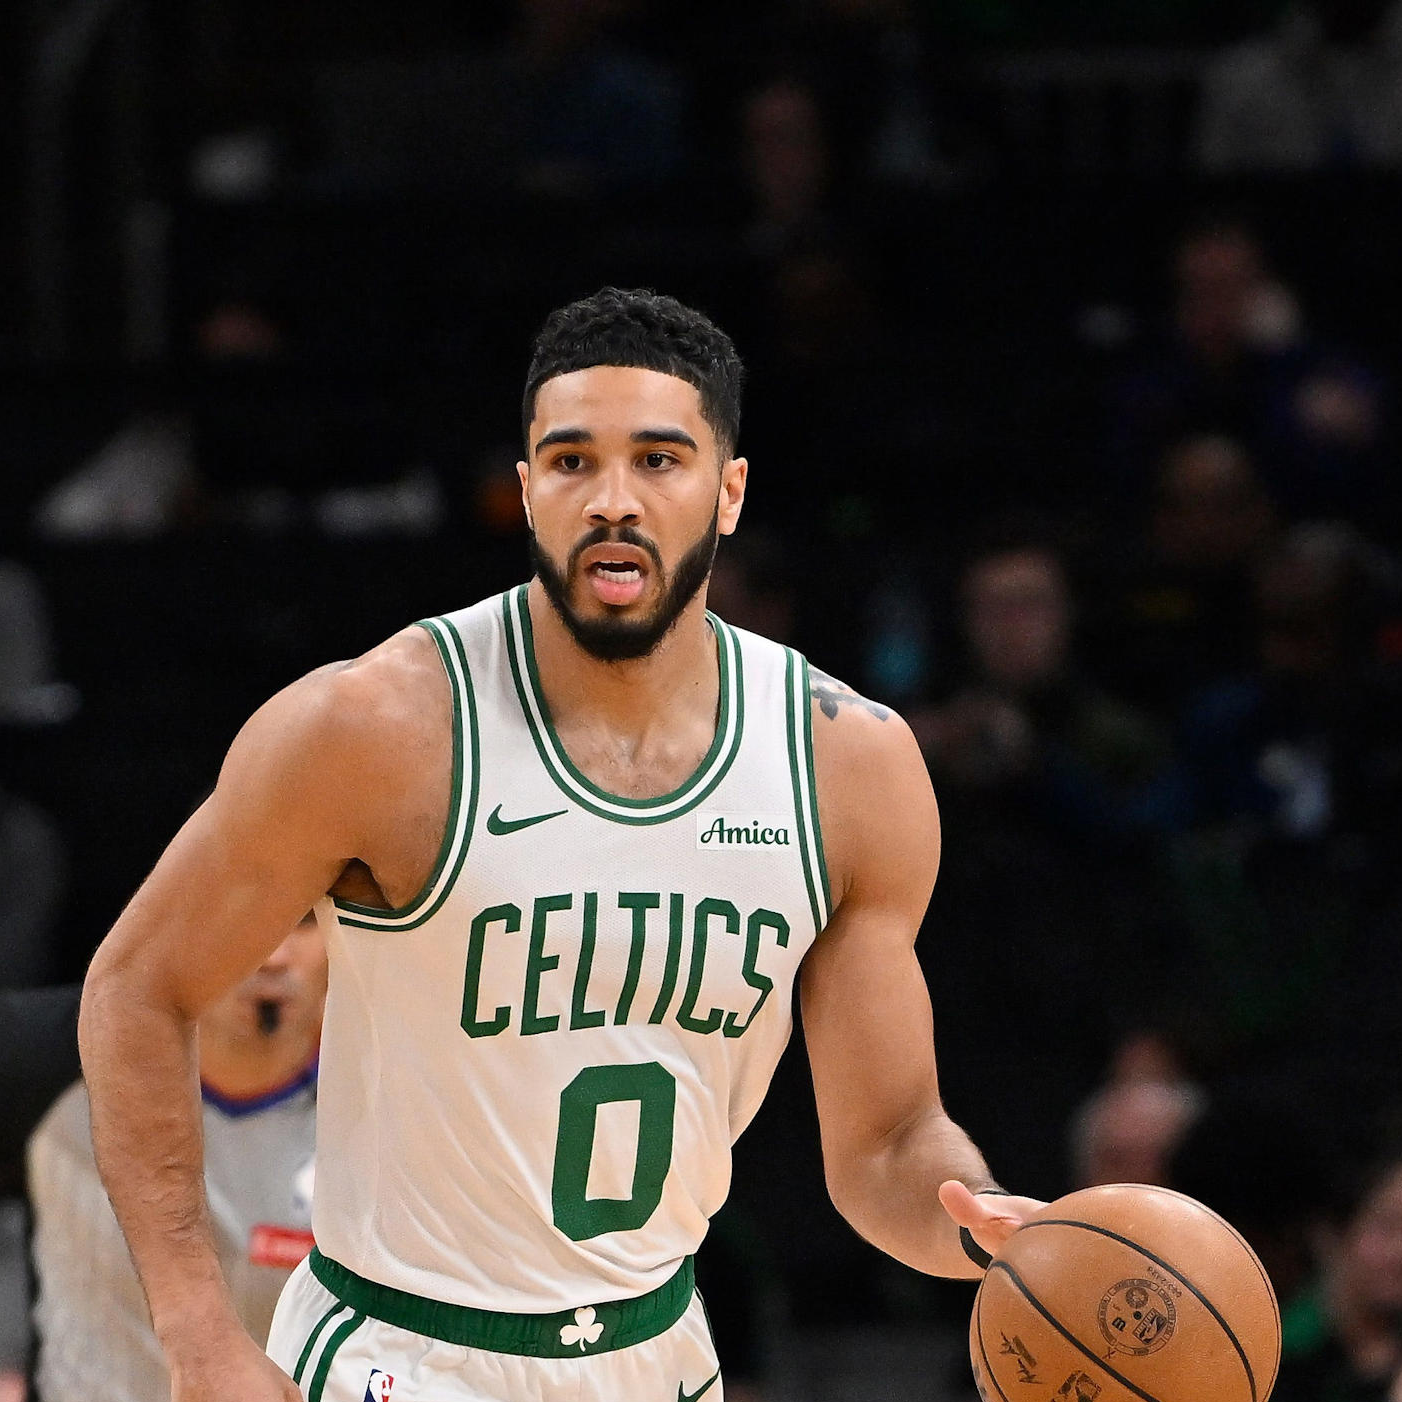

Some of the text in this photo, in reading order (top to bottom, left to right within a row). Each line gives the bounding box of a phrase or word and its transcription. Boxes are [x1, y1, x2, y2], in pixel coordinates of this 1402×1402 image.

[700, 817, 790, 845] Amica
[461, 892, 790, 1038] CELTICS
[552, 1062, 676, 1241] 0
